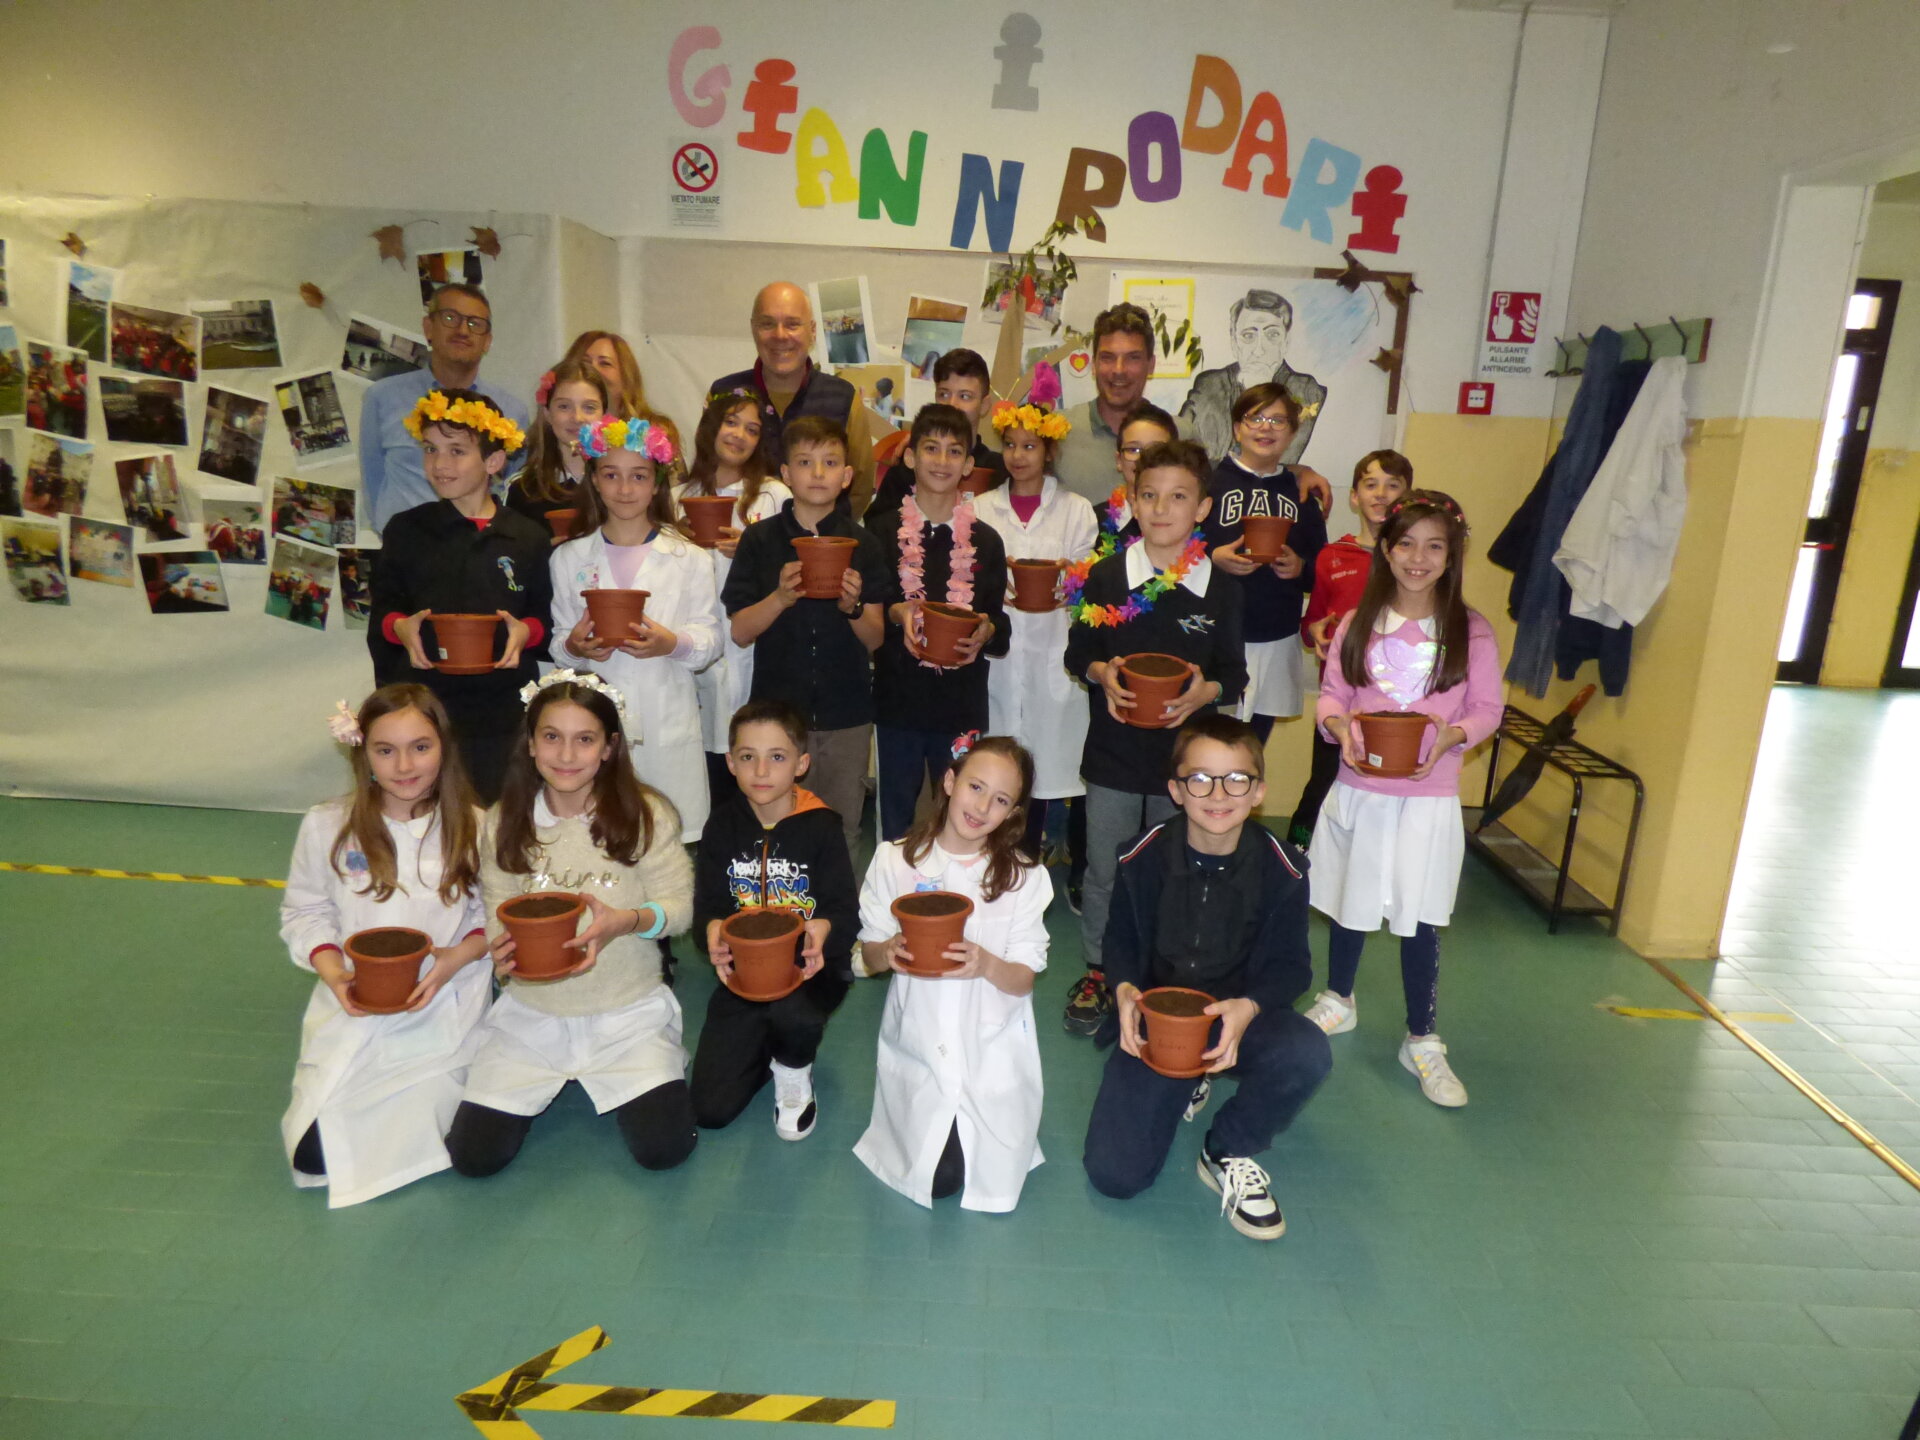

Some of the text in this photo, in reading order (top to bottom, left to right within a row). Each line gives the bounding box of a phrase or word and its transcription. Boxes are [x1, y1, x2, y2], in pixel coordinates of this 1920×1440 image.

[671, 195, 720, 205] VIETATO FUMARE
[1489, 346, 1530, 355] PULSANTE
[1489, 356, 1527, 364] ALLARME
[1481, 365, 1532, 374] ANTINCENDIO
[1219, 488, 1299, 527] GAP
